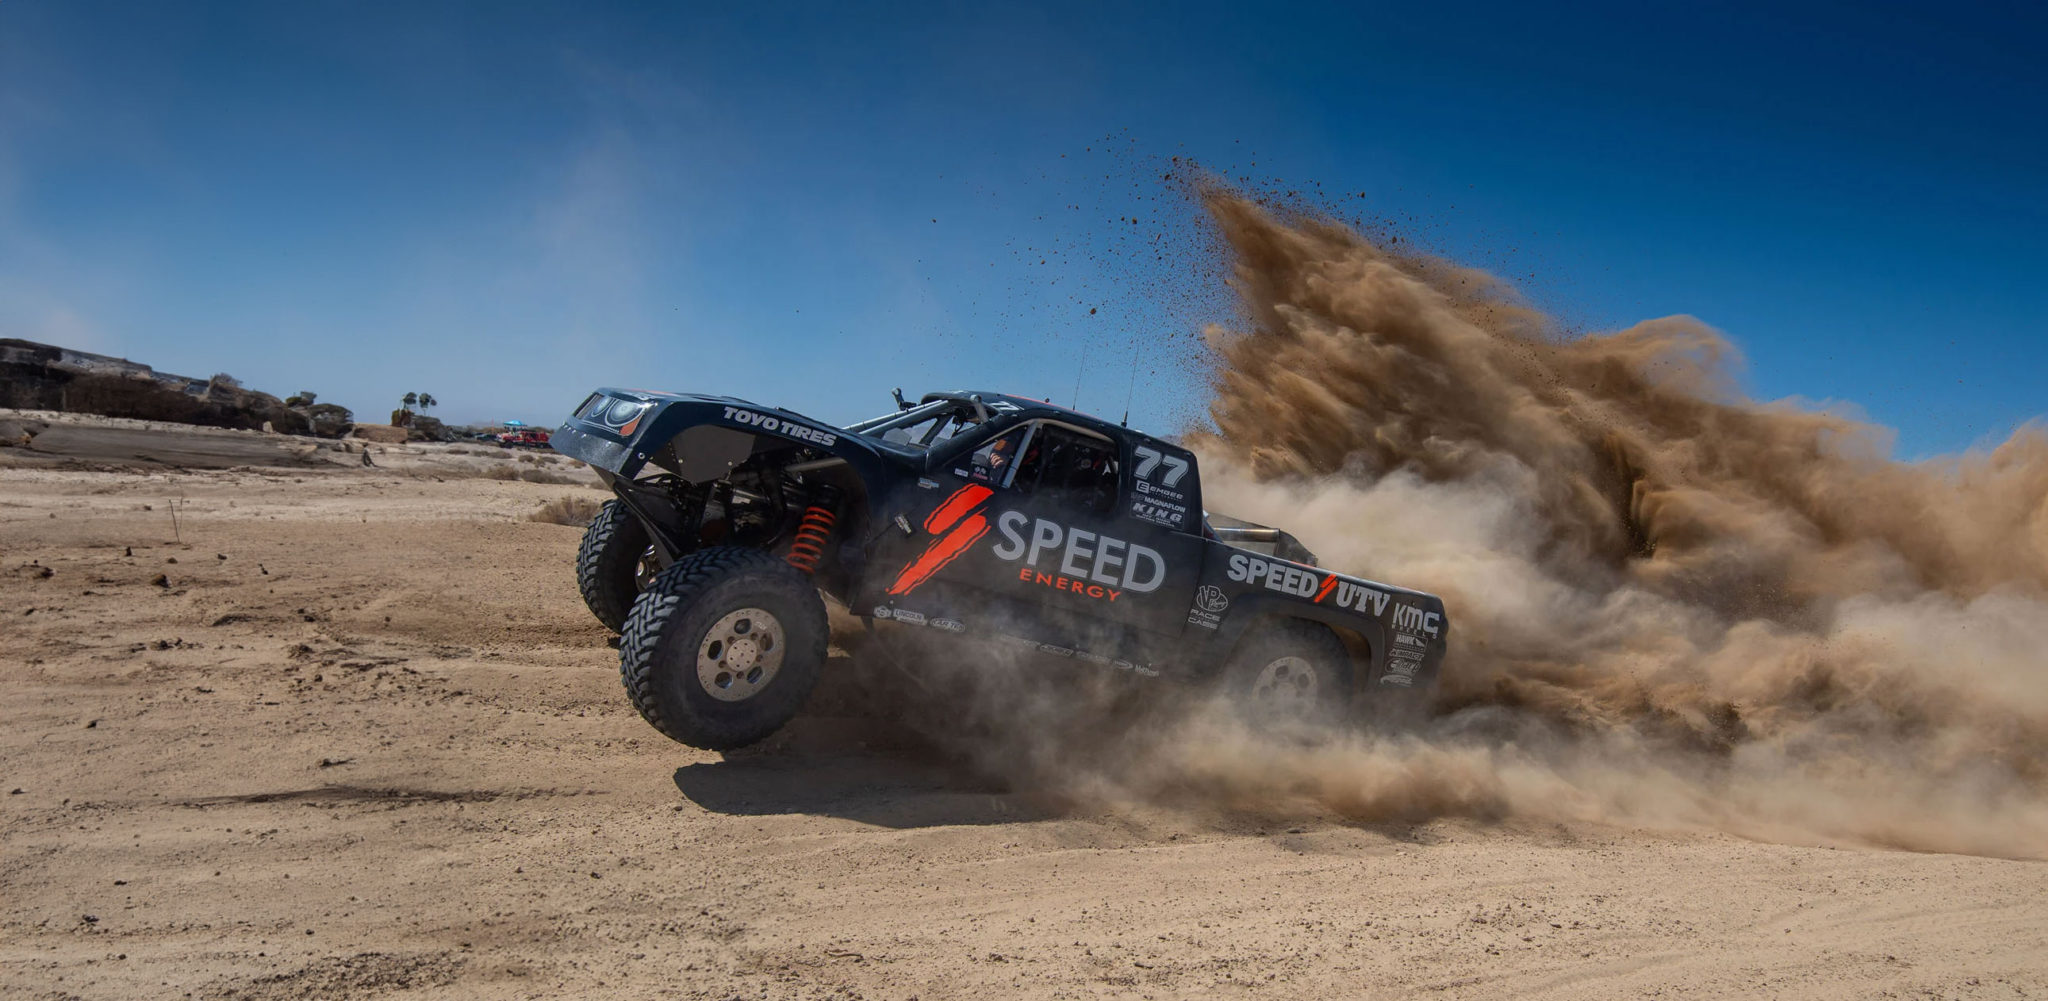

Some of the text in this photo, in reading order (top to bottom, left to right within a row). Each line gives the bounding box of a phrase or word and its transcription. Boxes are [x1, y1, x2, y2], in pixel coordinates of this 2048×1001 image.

[723, 406, 837, 447] TOYO TIRES
[1133, 445, 1190, 489] 77
[1132, 502, 1183, 522] KING
[1144, 496, 1187, 514] MAGNAFLOW
[992, 510, 1166, 593] SPEED
[1019, 568, 1121, 603] ENERGY
[1227, 554, 1391, 617] SPEED UTV
[894, 609, 925, 621] LINCOLN
[1190, 608, 1221, 622] RACE
[1396, 633, 1415, 646] HAWK
